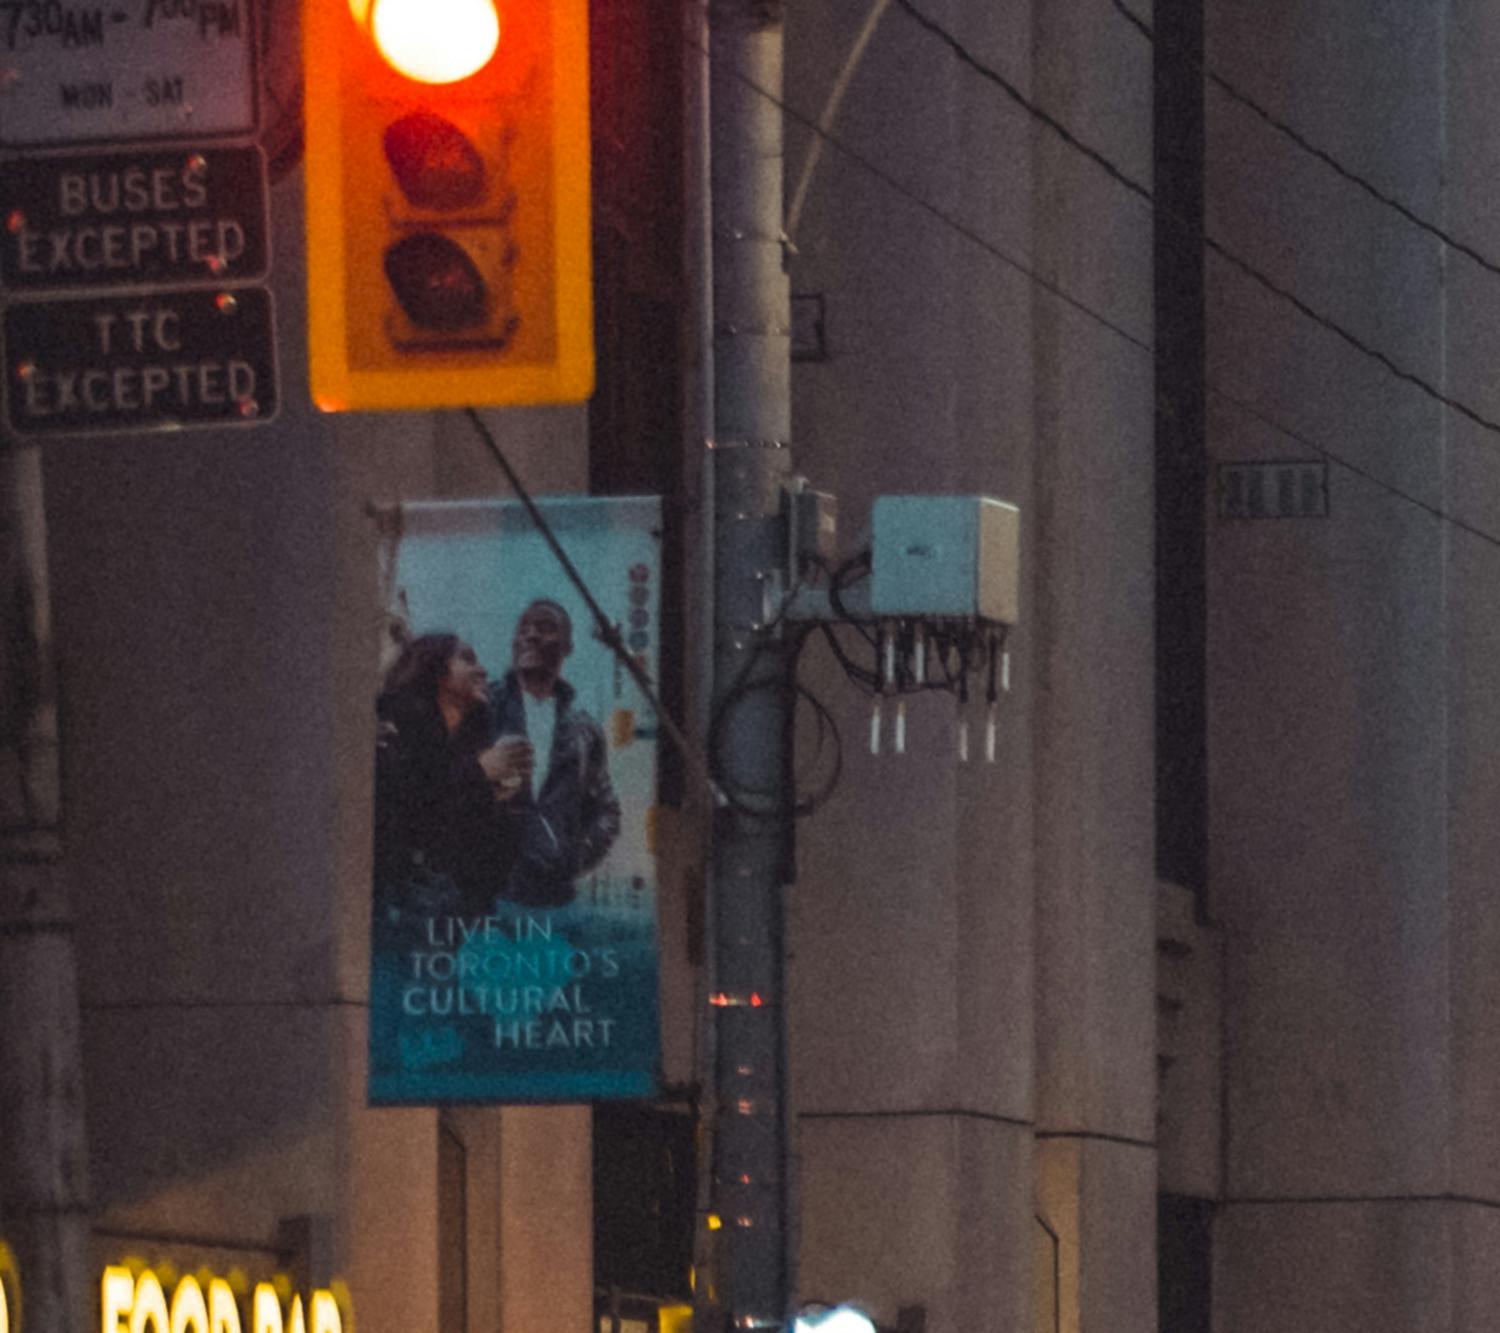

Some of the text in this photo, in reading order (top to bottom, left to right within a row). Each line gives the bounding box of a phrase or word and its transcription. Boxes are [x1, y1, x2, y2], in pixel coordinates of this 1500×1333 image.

[145, 77, 183, 107] SAT
[60, 167, 207, 215] BUSES
[18, 219, 246, 271] EXCEPTED
[97, 309, 181, 353] TTC
[26, 360, 256, 414] EXCEPTED
[427, 915, 552, 946] LIVE IN
[410, 949, 620, 980] TORONTO'S
[402, 984, 591, 1015] CULTURAL
[494, 1018, 616, 1049] HEART
